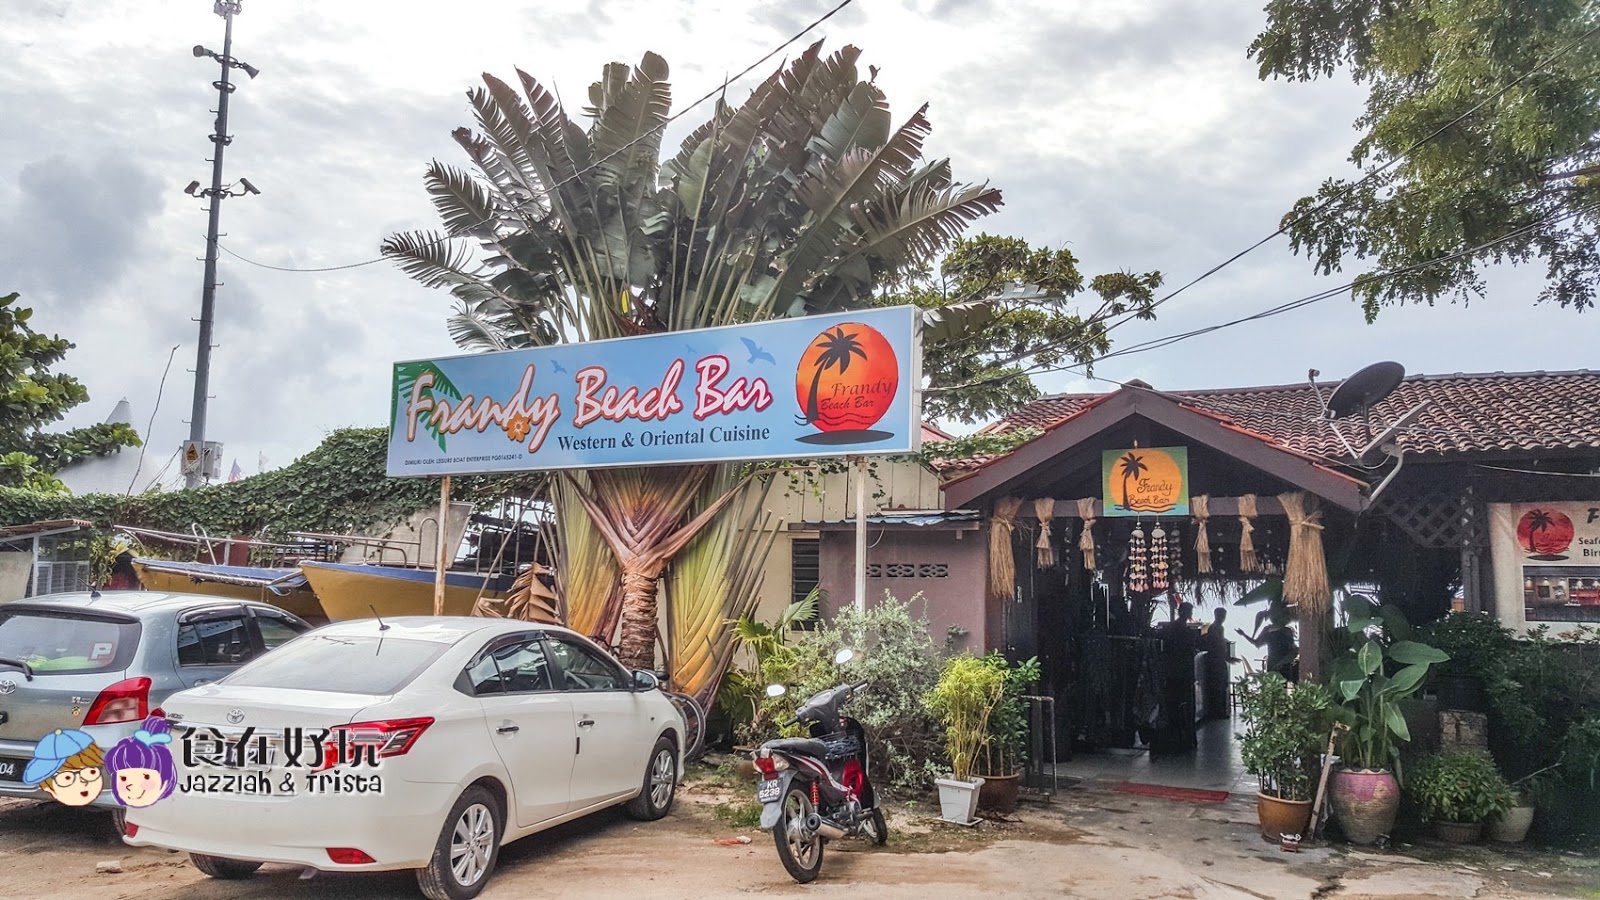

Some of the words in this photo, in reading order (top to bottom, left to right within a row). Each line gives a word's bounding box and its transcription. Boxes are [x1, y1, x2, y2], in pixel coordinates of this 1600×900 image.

[831, 376, 892, 398] Frandy
[406, 363, 561, 453] Frandy
[573, 357, 685, 429] Beach
[693, 354, 773, 421] Bar
[820, 397, 850, 411] Beach
[854, 395, 874, 409] Bar
[557, 434, 617, 451] Western
[621, 431, 635, 448] &
[640, 427, 705, 447] Oriental
[709, 424, 770, 443] Cuisine
[1136, 478, 1174, 497] Frandy
[1128, 494, 1152, 505] Beach
[1152, 495, 1170, 505] Bar
[91, 643, 113, 659] P
[766, 779, 778, 789] KR
